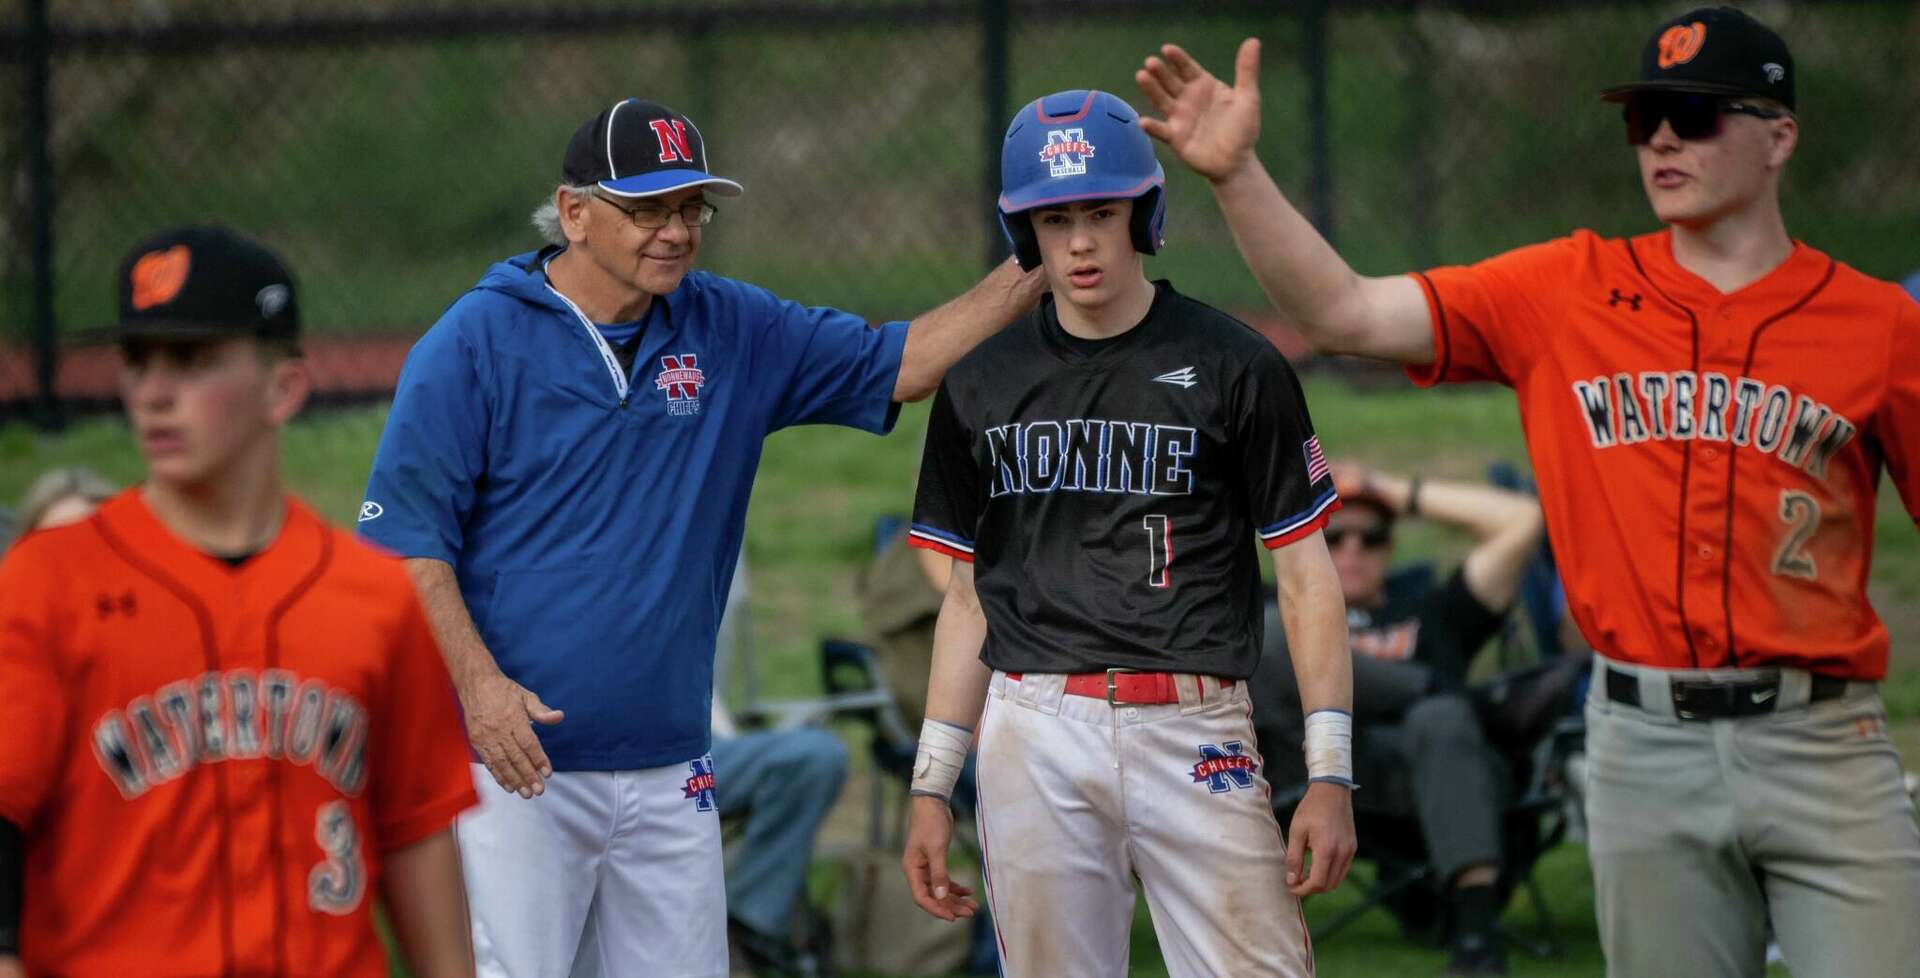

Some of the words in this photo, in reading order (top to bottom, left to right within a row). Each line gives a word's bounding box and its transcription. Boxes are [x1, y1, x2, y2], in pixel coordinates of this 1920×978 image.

[649, 119, 693, 163] N
[1046, 142, 1087, 157] CHIEFS
[661, 353, 699, 401] N
[666, 400, 700, 416] CHIEFS
[1572, 370, 1857, 481] WATERTOWN
[985, 419, 1199, 498] NONNE
[1144, 514, 1175, 589] 1
[1770, 488, 1822, 581] 2
[91, 667, 369, 800] WATERTOWN
[1197, 757, 1252, 777] CHIEFS
[1199, 741, 1253, 794] N
[307, 798, 367, 916] 3
